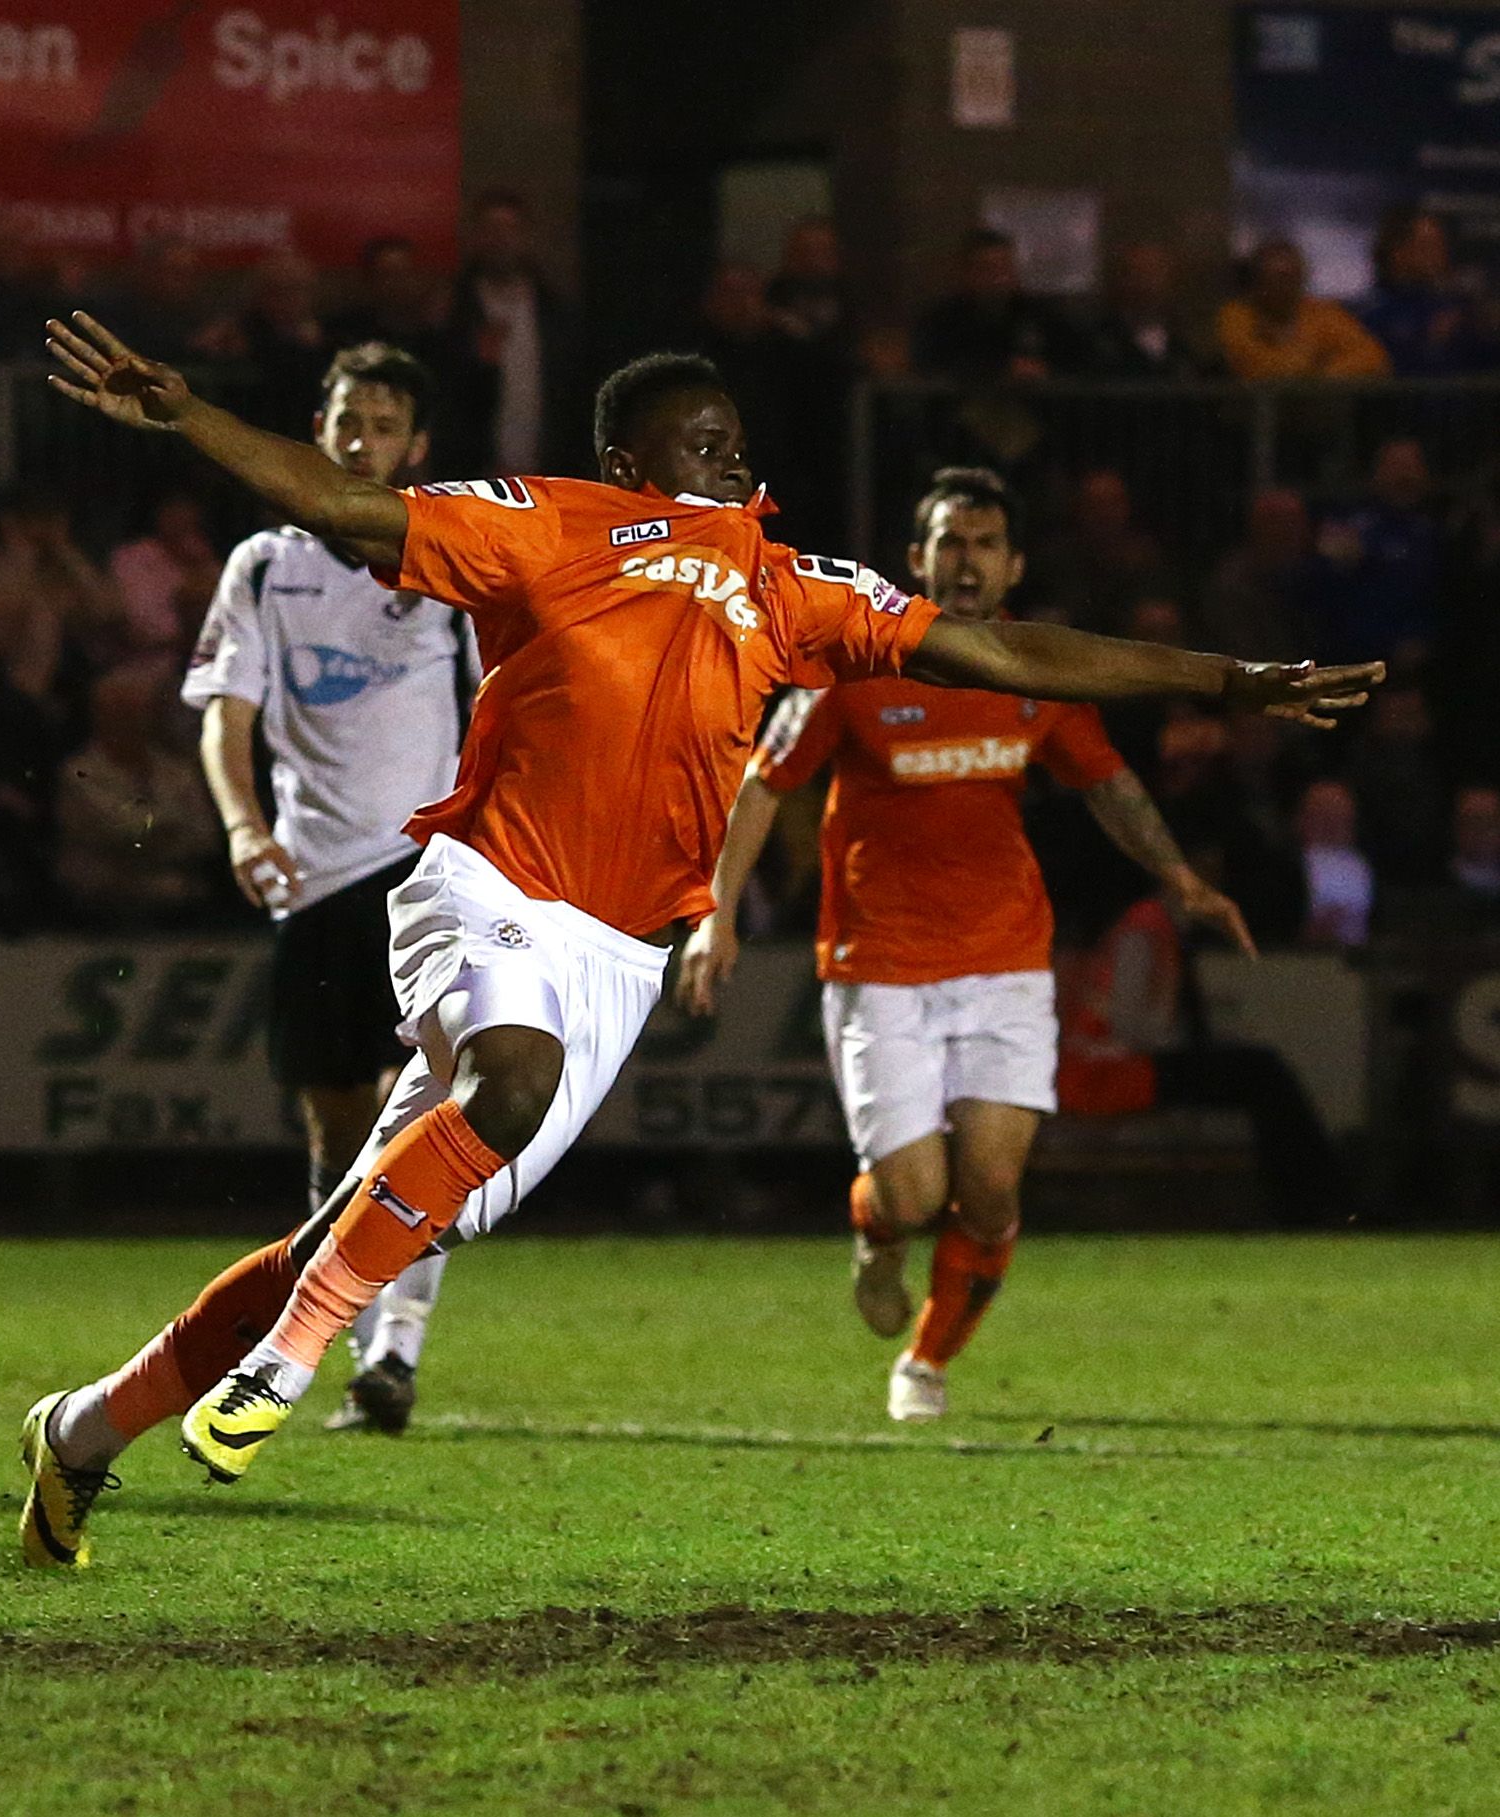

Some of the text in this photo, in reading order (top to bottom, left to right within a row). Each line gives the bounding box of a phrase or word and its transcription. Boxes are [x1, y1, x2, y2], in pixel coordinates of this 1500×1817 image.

[212, 9, 432, 100] Spice
[616, 523, 664, 543] FILA
[892, 737, 1030, 779] easyJet
